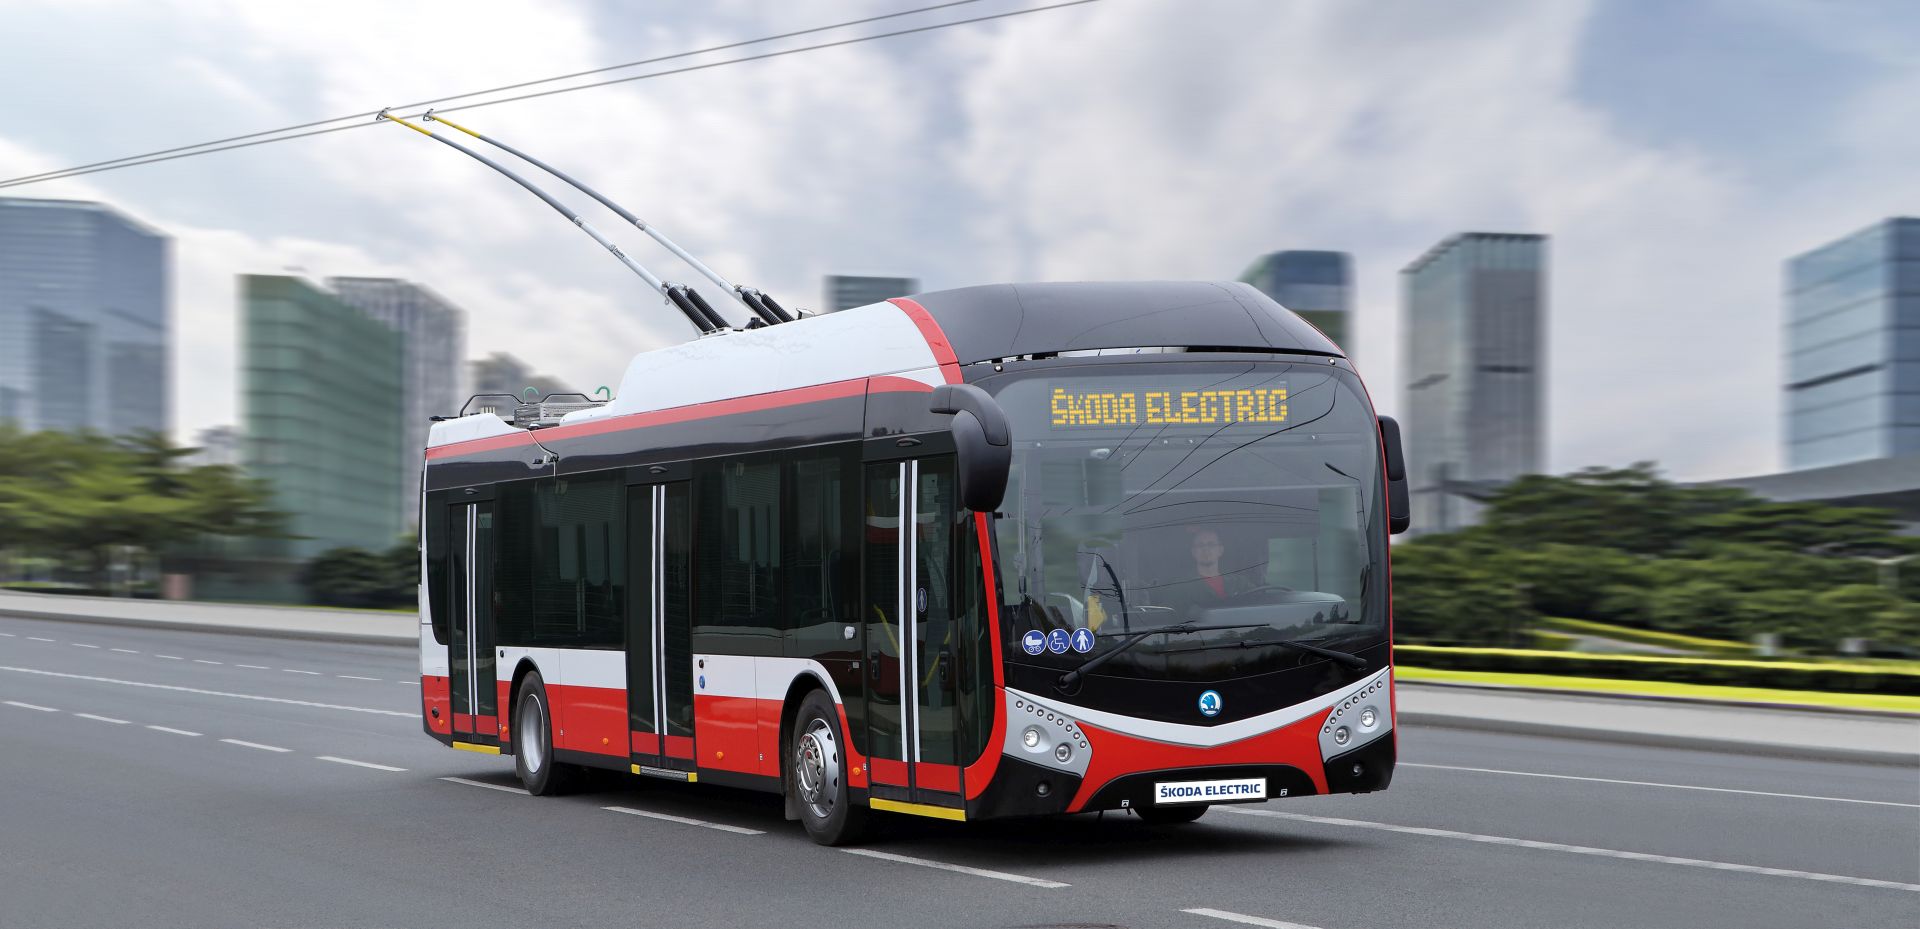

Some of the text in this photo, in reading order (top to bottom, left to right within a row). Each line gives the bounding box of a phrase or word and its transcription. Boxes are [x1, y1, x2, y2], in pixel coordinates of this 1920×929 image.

[1051, 388, 1288, 425] ŠKODA ELECTRIC
[1160, 783, 1261, 798] ŠKODA ELECTRIC
